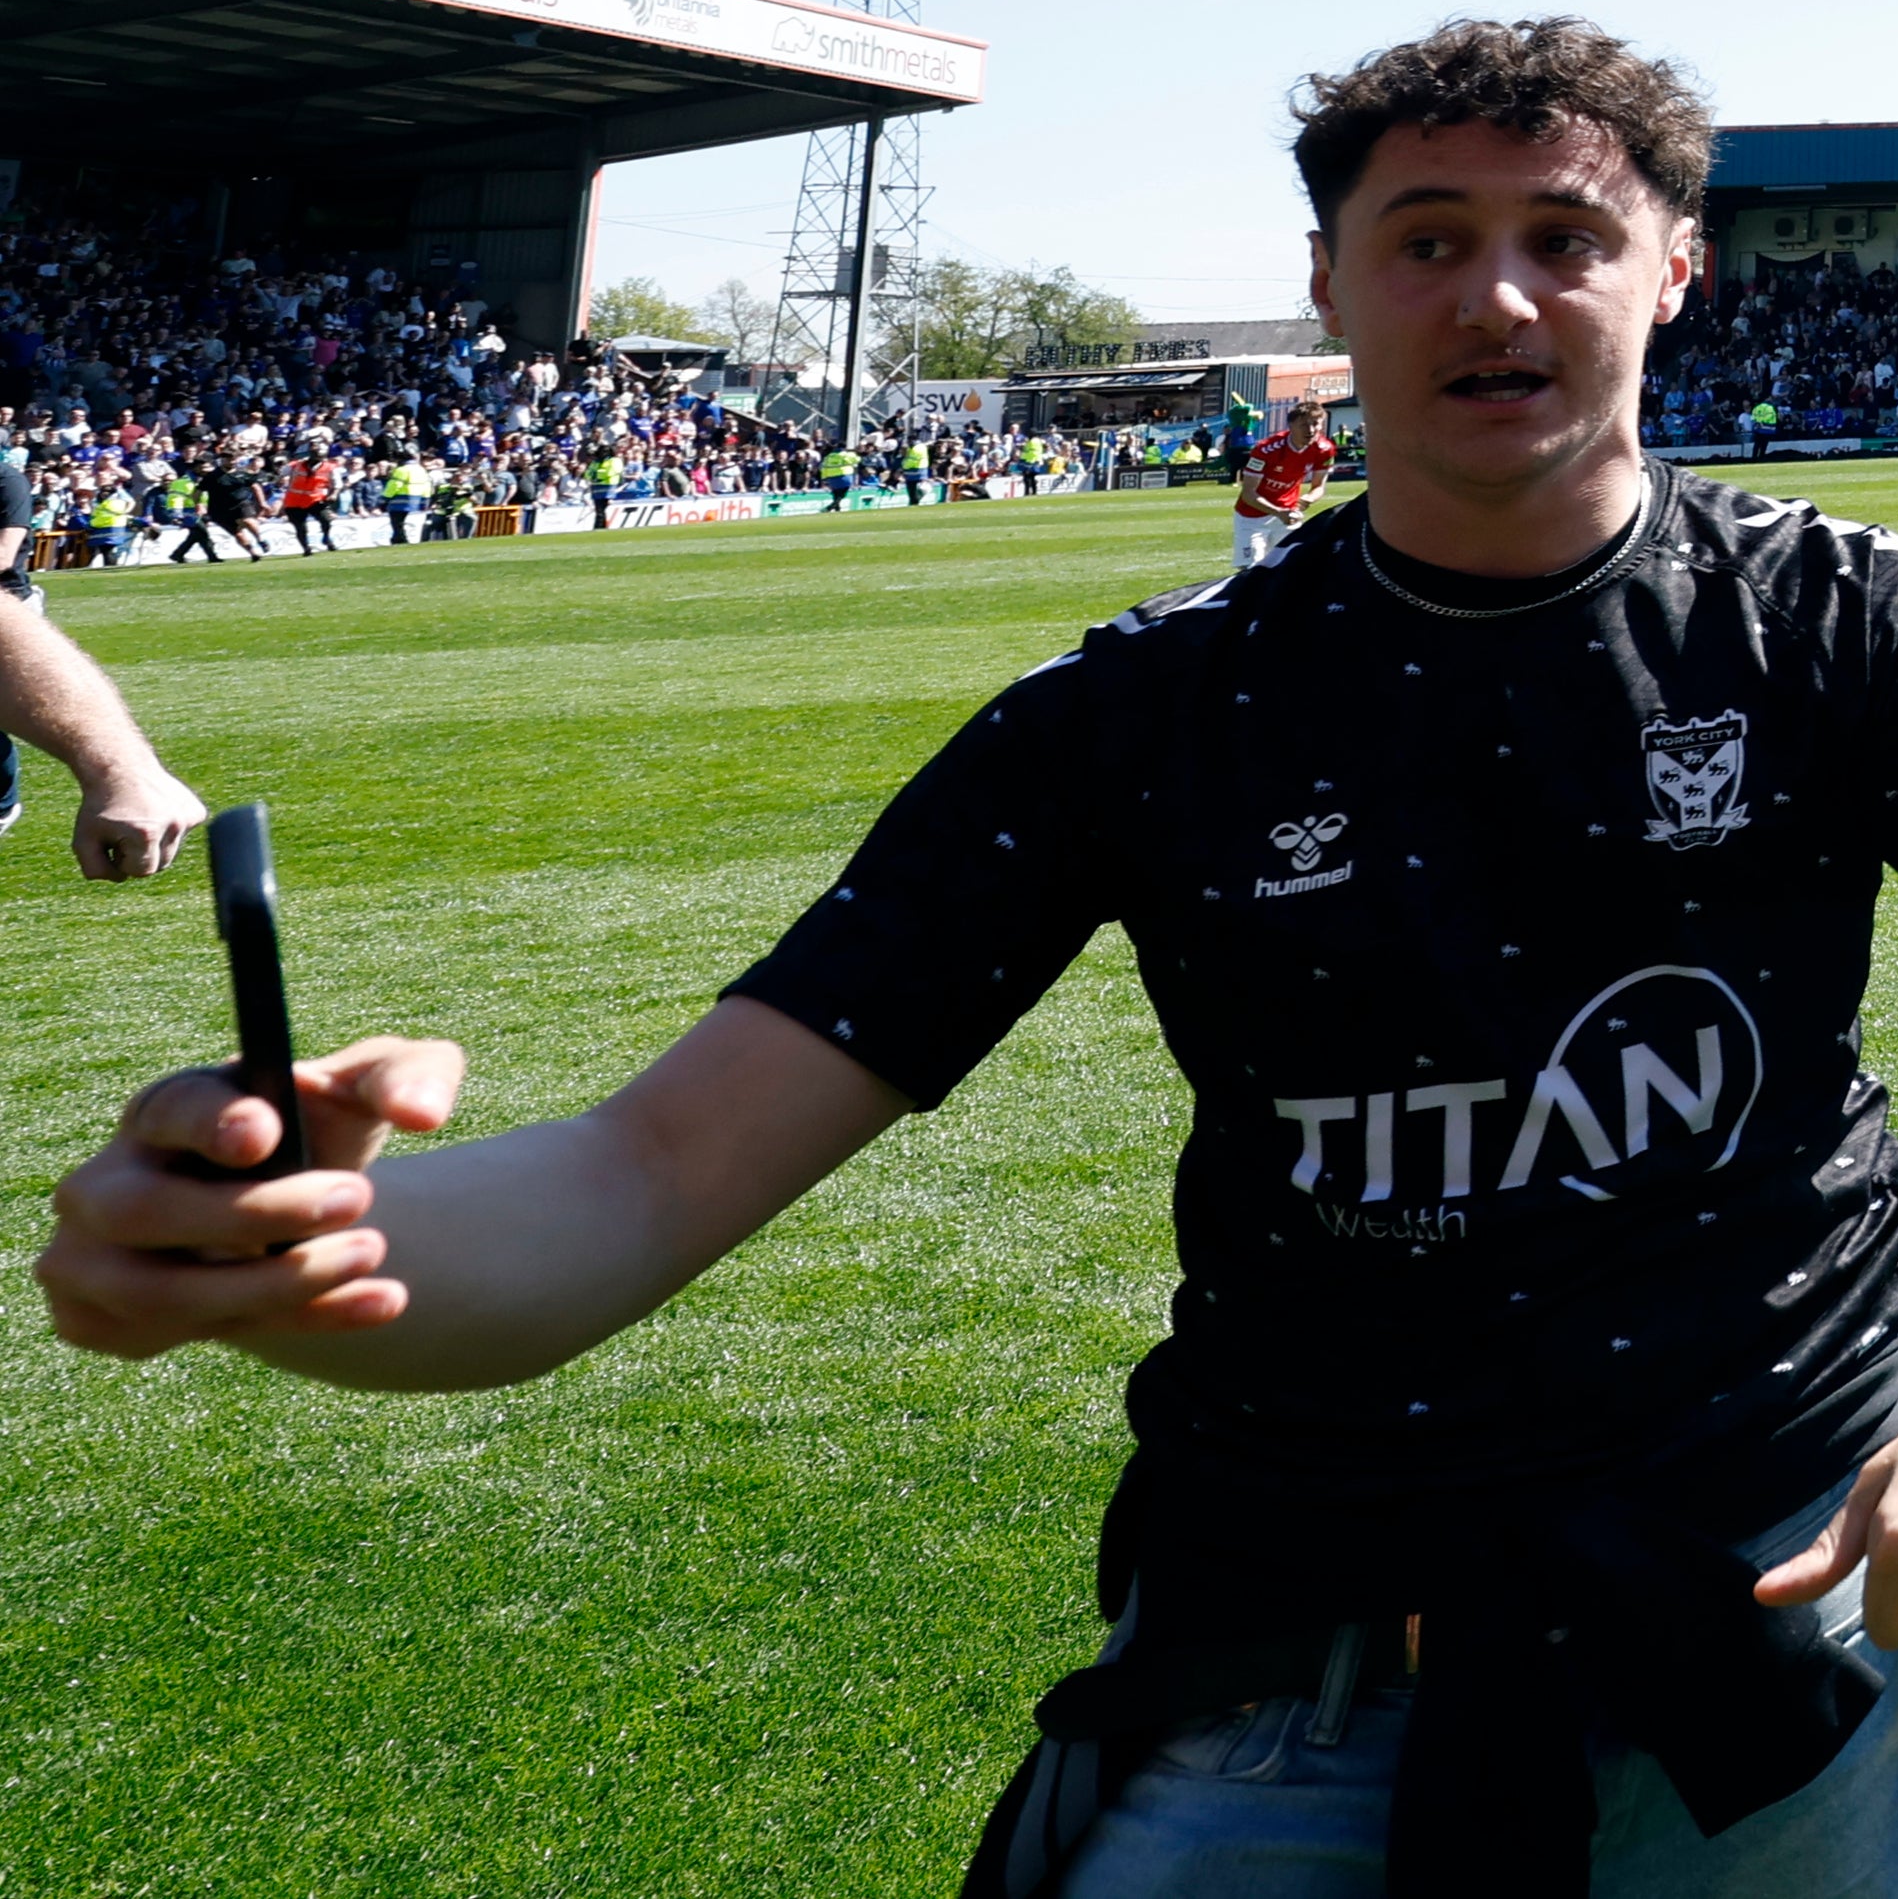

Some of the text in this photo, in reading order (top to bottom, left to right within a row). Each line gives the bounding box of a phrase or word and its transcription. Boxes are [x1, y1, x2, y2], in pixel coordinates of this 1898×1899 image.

[654, 11, 699, 34] metals
[817, 32, 957, 85] smithmetals
[1025, 338, 1211, 368] FILTHY FRIES
[1653, 727, 1735, 747] YORK CITY
[1254, 860, 1354, 898] hummel
[1273, 1024, 1721, 1202] TITAN
